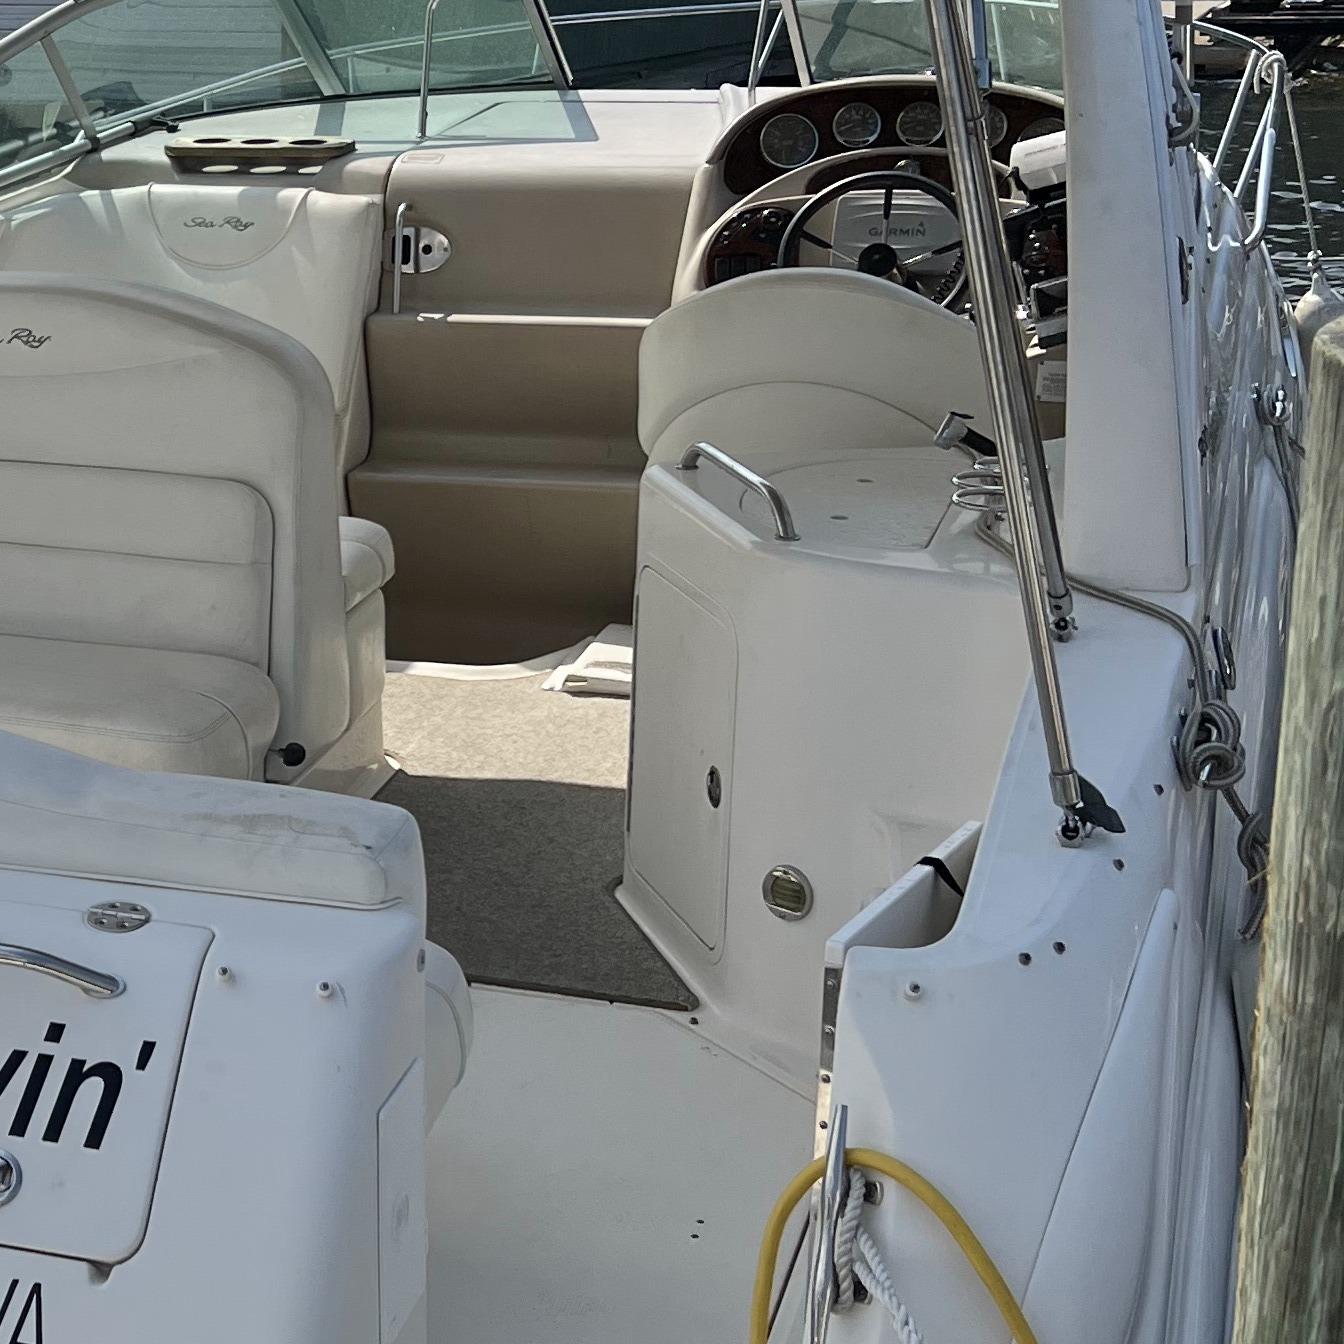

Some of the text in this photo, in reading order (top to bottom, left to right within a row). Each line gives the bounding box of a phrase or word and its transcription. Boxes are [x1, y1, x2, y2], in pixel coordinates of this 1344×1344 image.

[183, 216, 255, 232] Sea Ray
[6, 327, 52, 349] Ray
